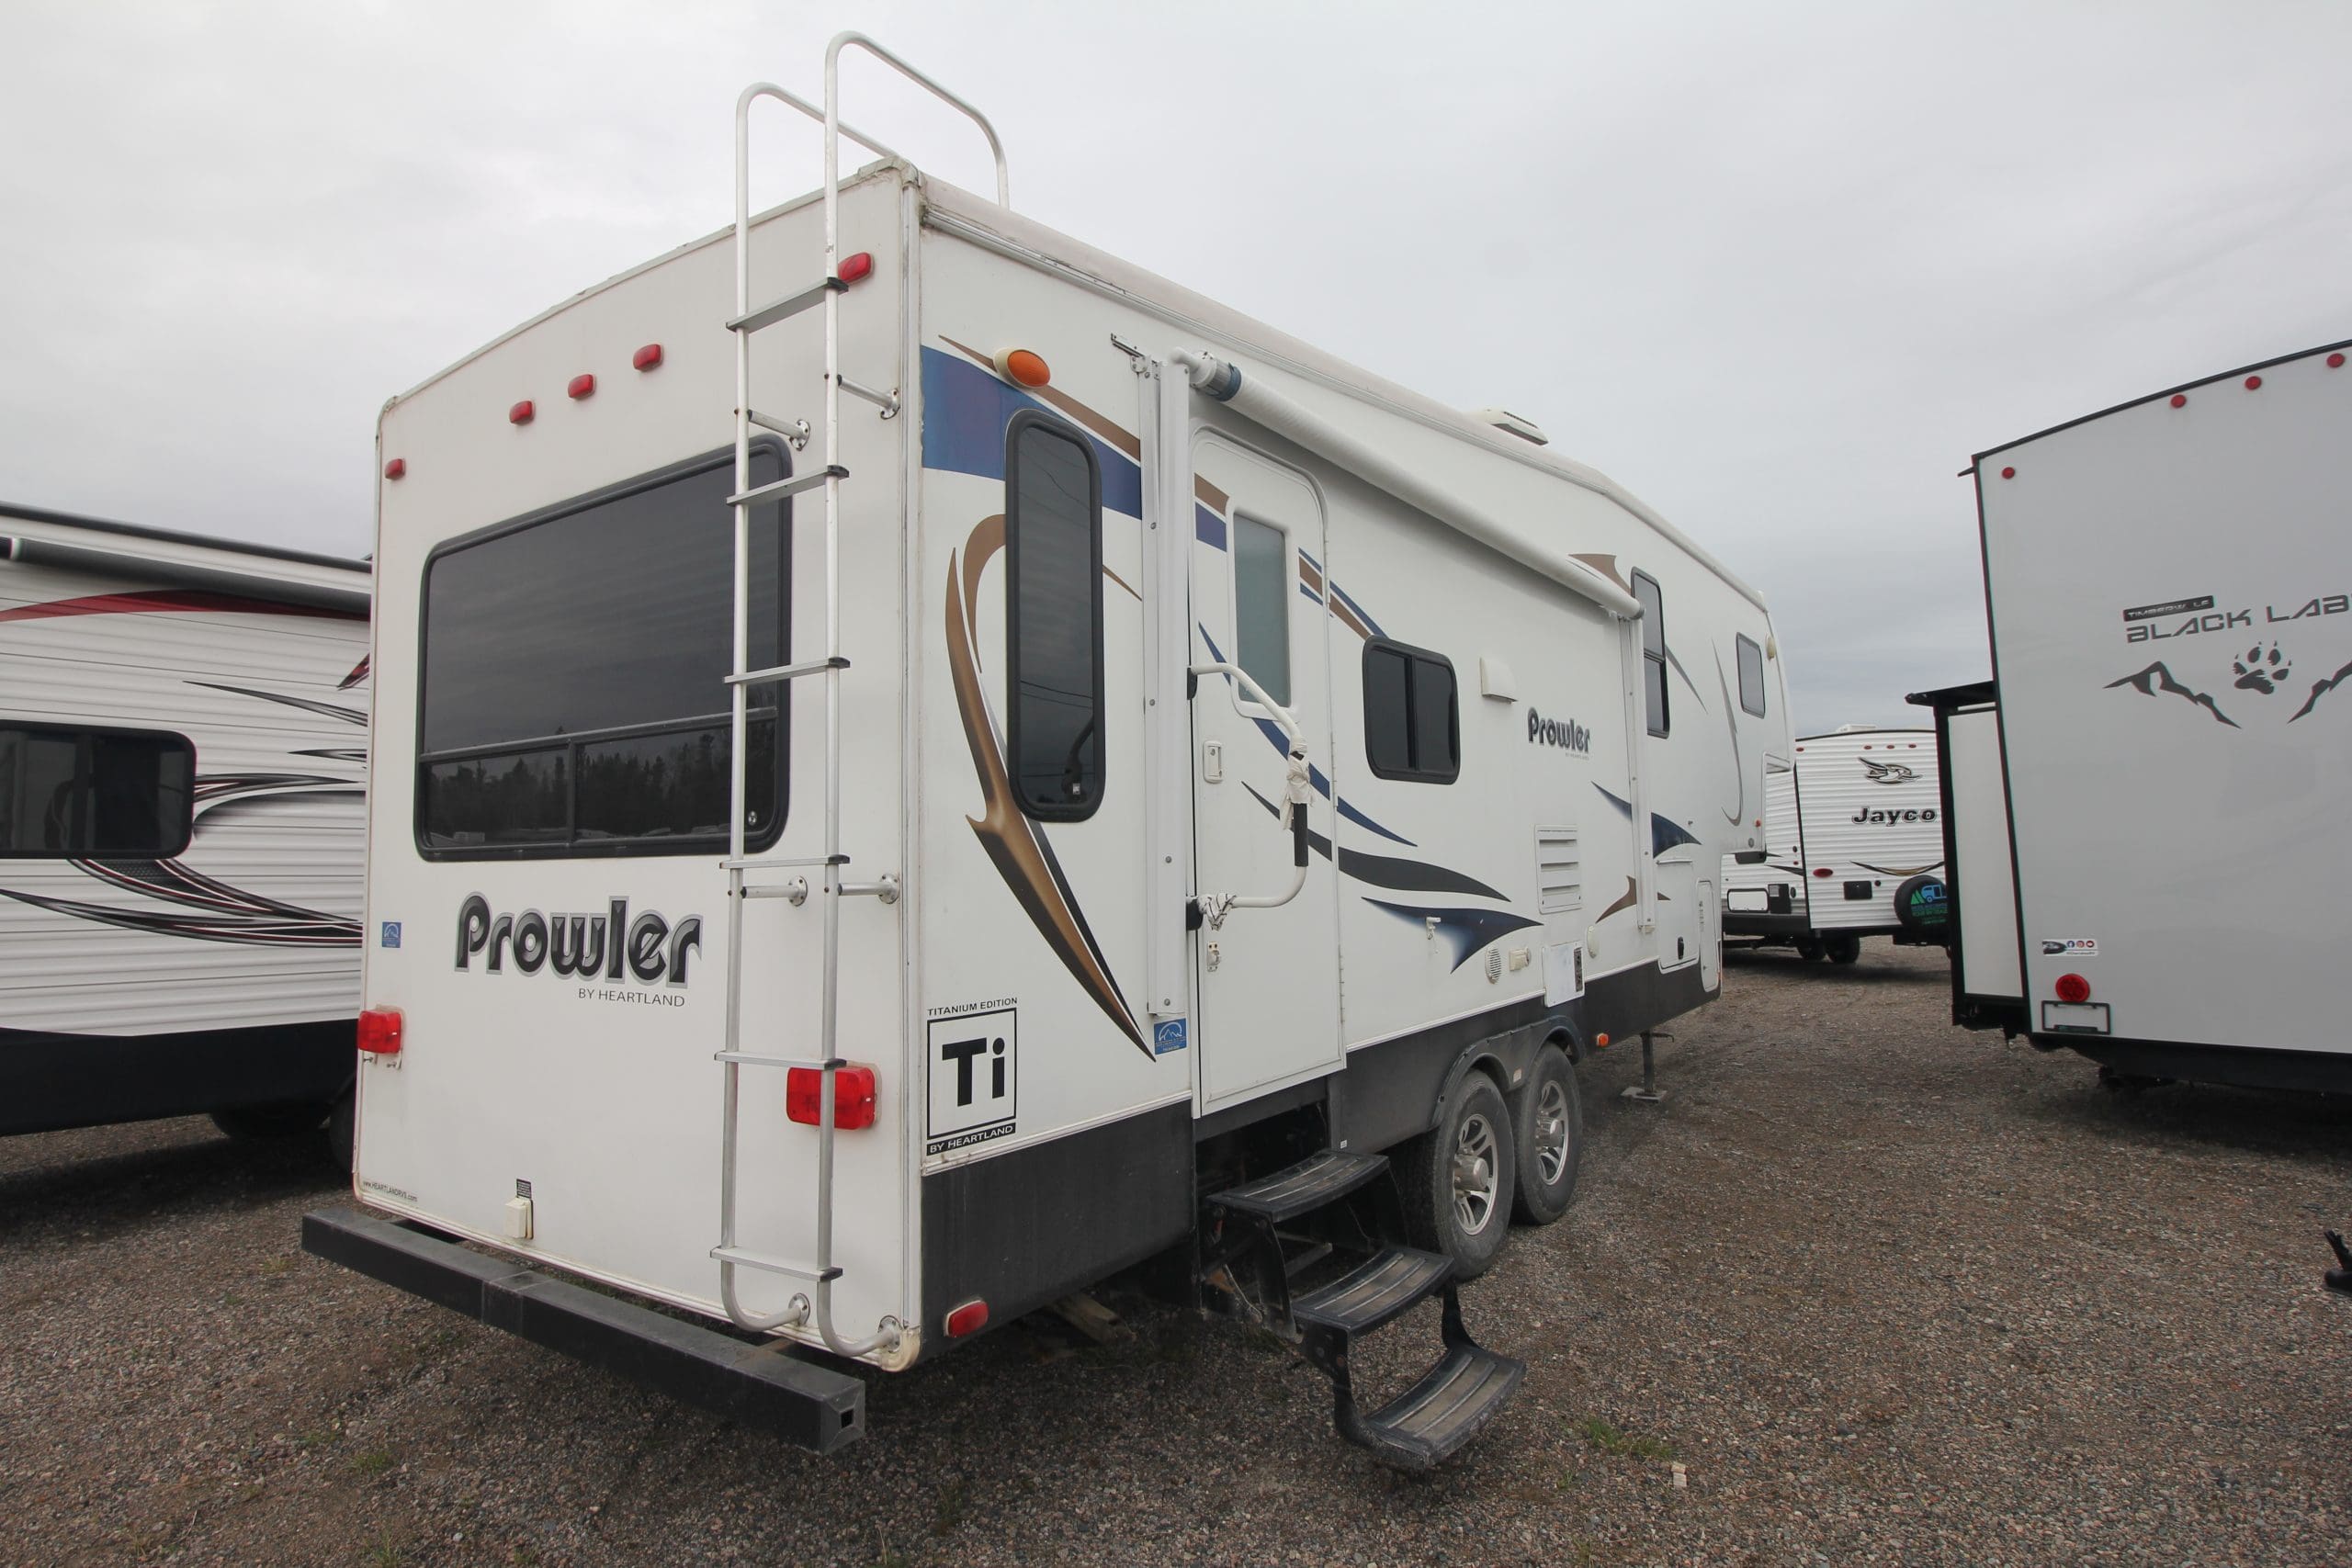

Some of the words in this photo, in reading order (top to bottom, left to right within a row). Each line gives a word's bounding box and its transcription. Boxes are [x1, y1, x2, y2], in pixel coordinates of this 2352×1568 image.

[2126, 608, 2252, 643] BLACK
[2266, 594, 2352, 623] LAB
[1527, 706, 1590, 753] Prowler
[1851, 806, 1937, 827] Jayco
[454, 891, 704, 989] Prowler
[578, 988, 595, 999] BY
[598, 989, 685, 1007] HEARTLAND
[927, 1002, 978, 1017] TITANIUM
[980, 998, 1018, 1010] EDITION
[942, 1037, 1005, 1107] Ti
[930, 1143, 947, 1154] BY
[947, 1125, 1013, 1149] HEARTLAND
